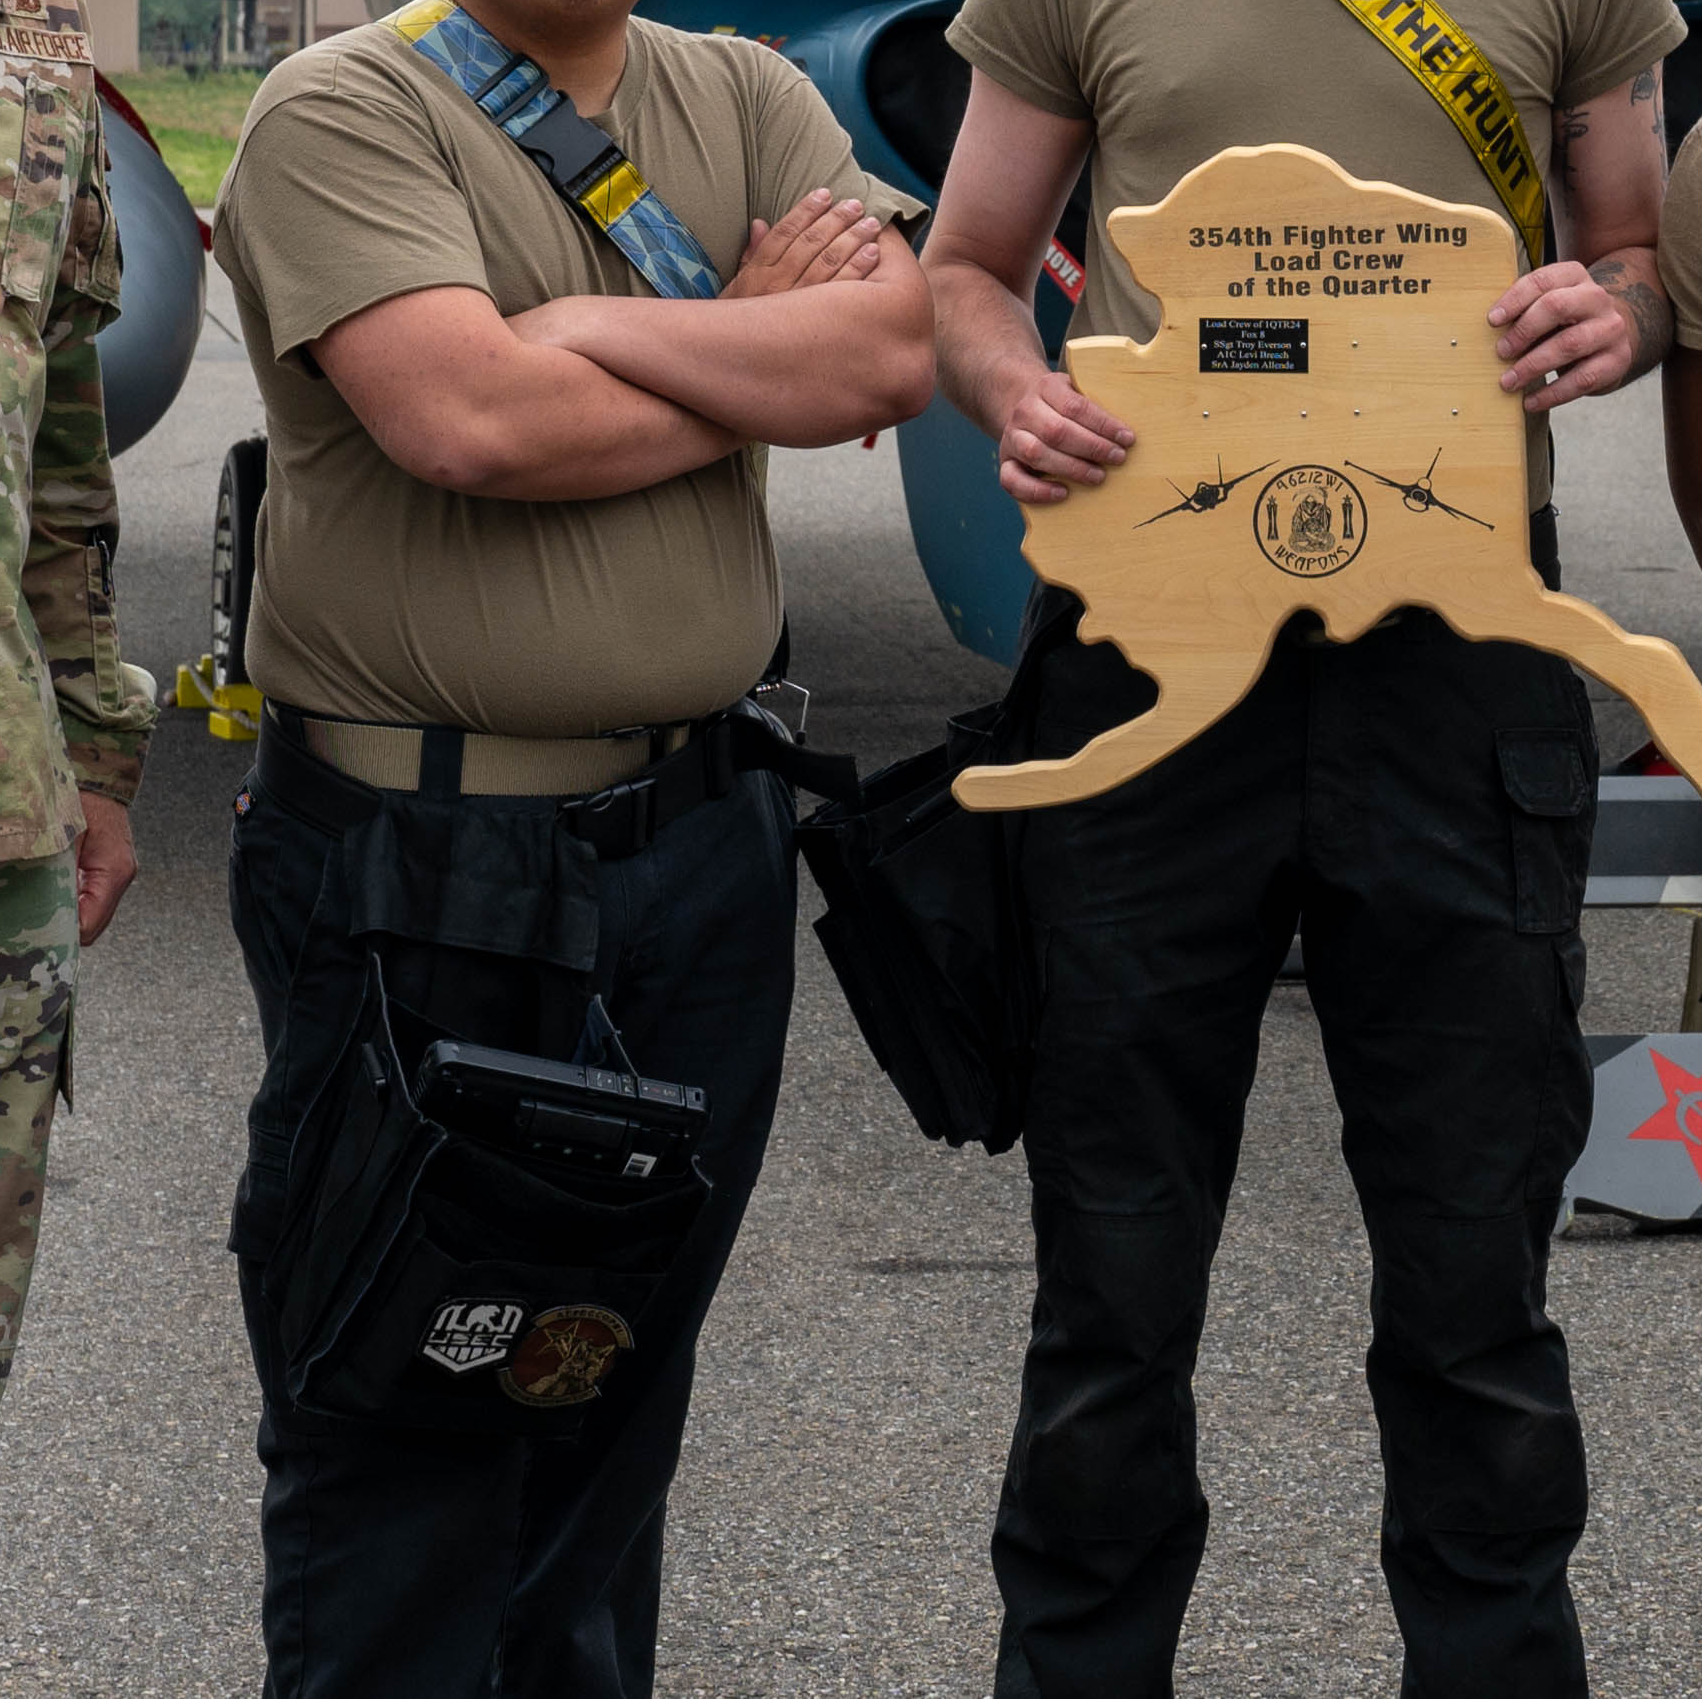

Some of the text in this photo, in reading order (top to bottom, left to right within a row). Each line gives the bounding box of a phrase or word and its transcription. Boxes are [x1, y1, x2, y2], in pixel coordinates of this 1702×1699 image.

[6, 27, 36, 55] AIR
[33, 32, 90, 60] FORCE
[1450, 70, 1530, 190] HUNT
[1189, 223, 1467, 249] 354th Fighter Wing
[1255, 250, 1404, 271] Load Crew
[1228, 275, 1431, 298] of the Quarter
[1206, 320, 1227, 329] Load
[1228, 320, 1251, 329] Crew
[1252, 320, 1264, 329] of
[1241, 330, 1258, 339] Fox
[1213, 340, 1292, 351] SSgt Troy Everson
[1239, 350, 1258, 359] Levi
[1230, 361, 1259, 370] Jayden
[1274, 544, 1350, 572] WEAPONS
